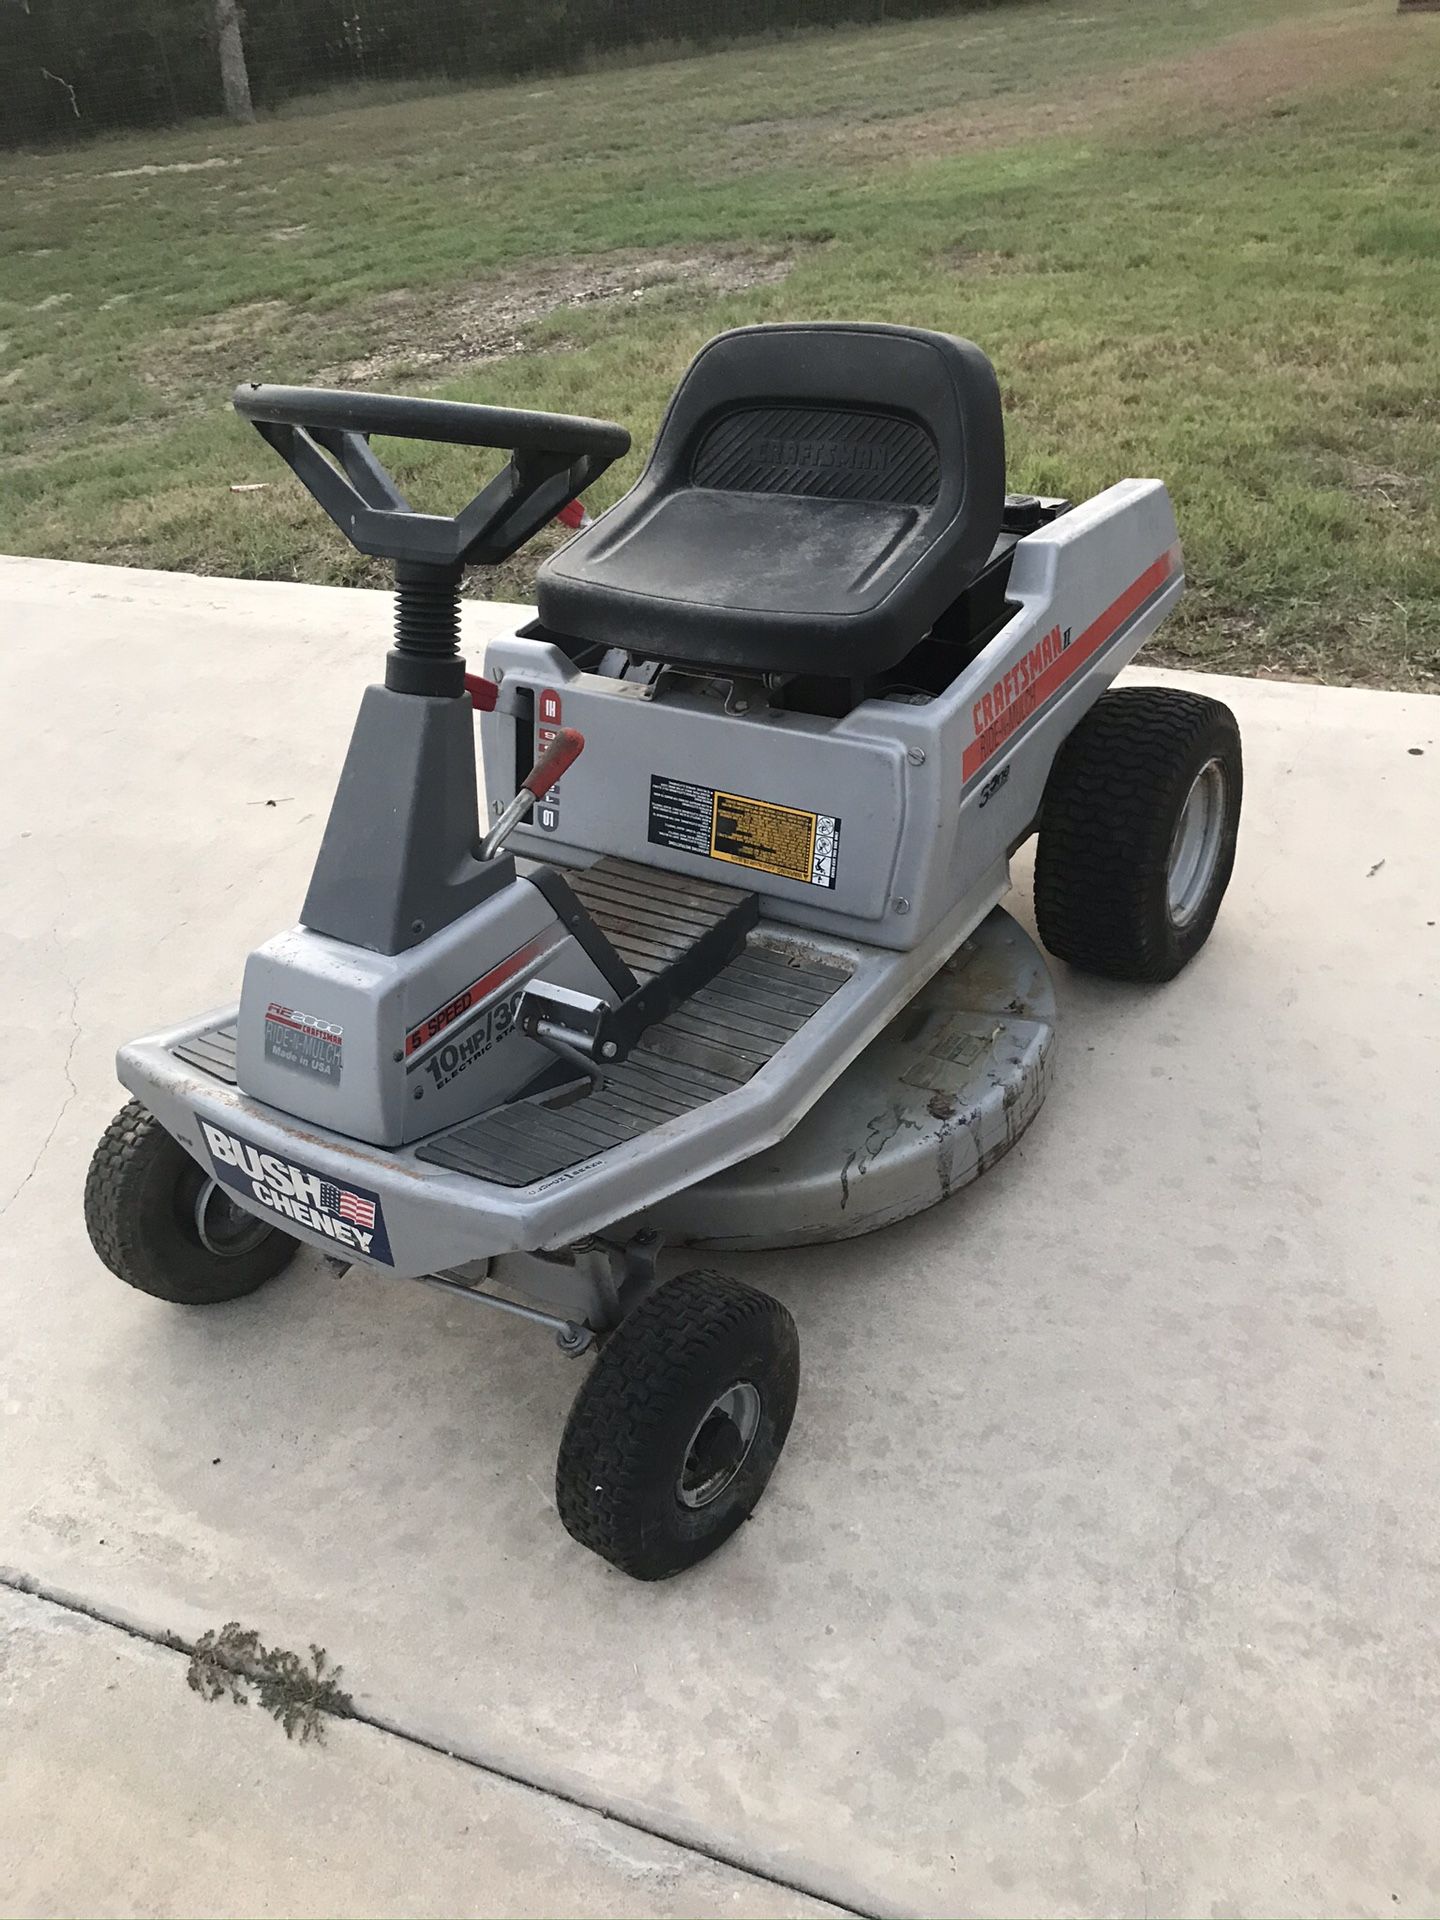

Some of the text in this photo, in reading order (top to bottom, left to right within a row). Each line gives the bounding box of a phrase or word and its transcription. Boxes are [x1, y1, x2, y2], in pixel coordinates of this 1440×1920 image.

[755, 439, 888, 470] CRAFTSMAN
[972, 624, 1064, 736] CRAFTSMAN
[302, 1025, 343, 1047] CRAFTSMAN
[412, 992, 472, 1049] 5 SPEED
[272, 1045, 332, 1075] Made in USA
[436, 1042, 493, 1090] ELECTRIC
[202, 1121, 325, 1213] BUSH
[252, 1181, 374, 1254] CHENEY
